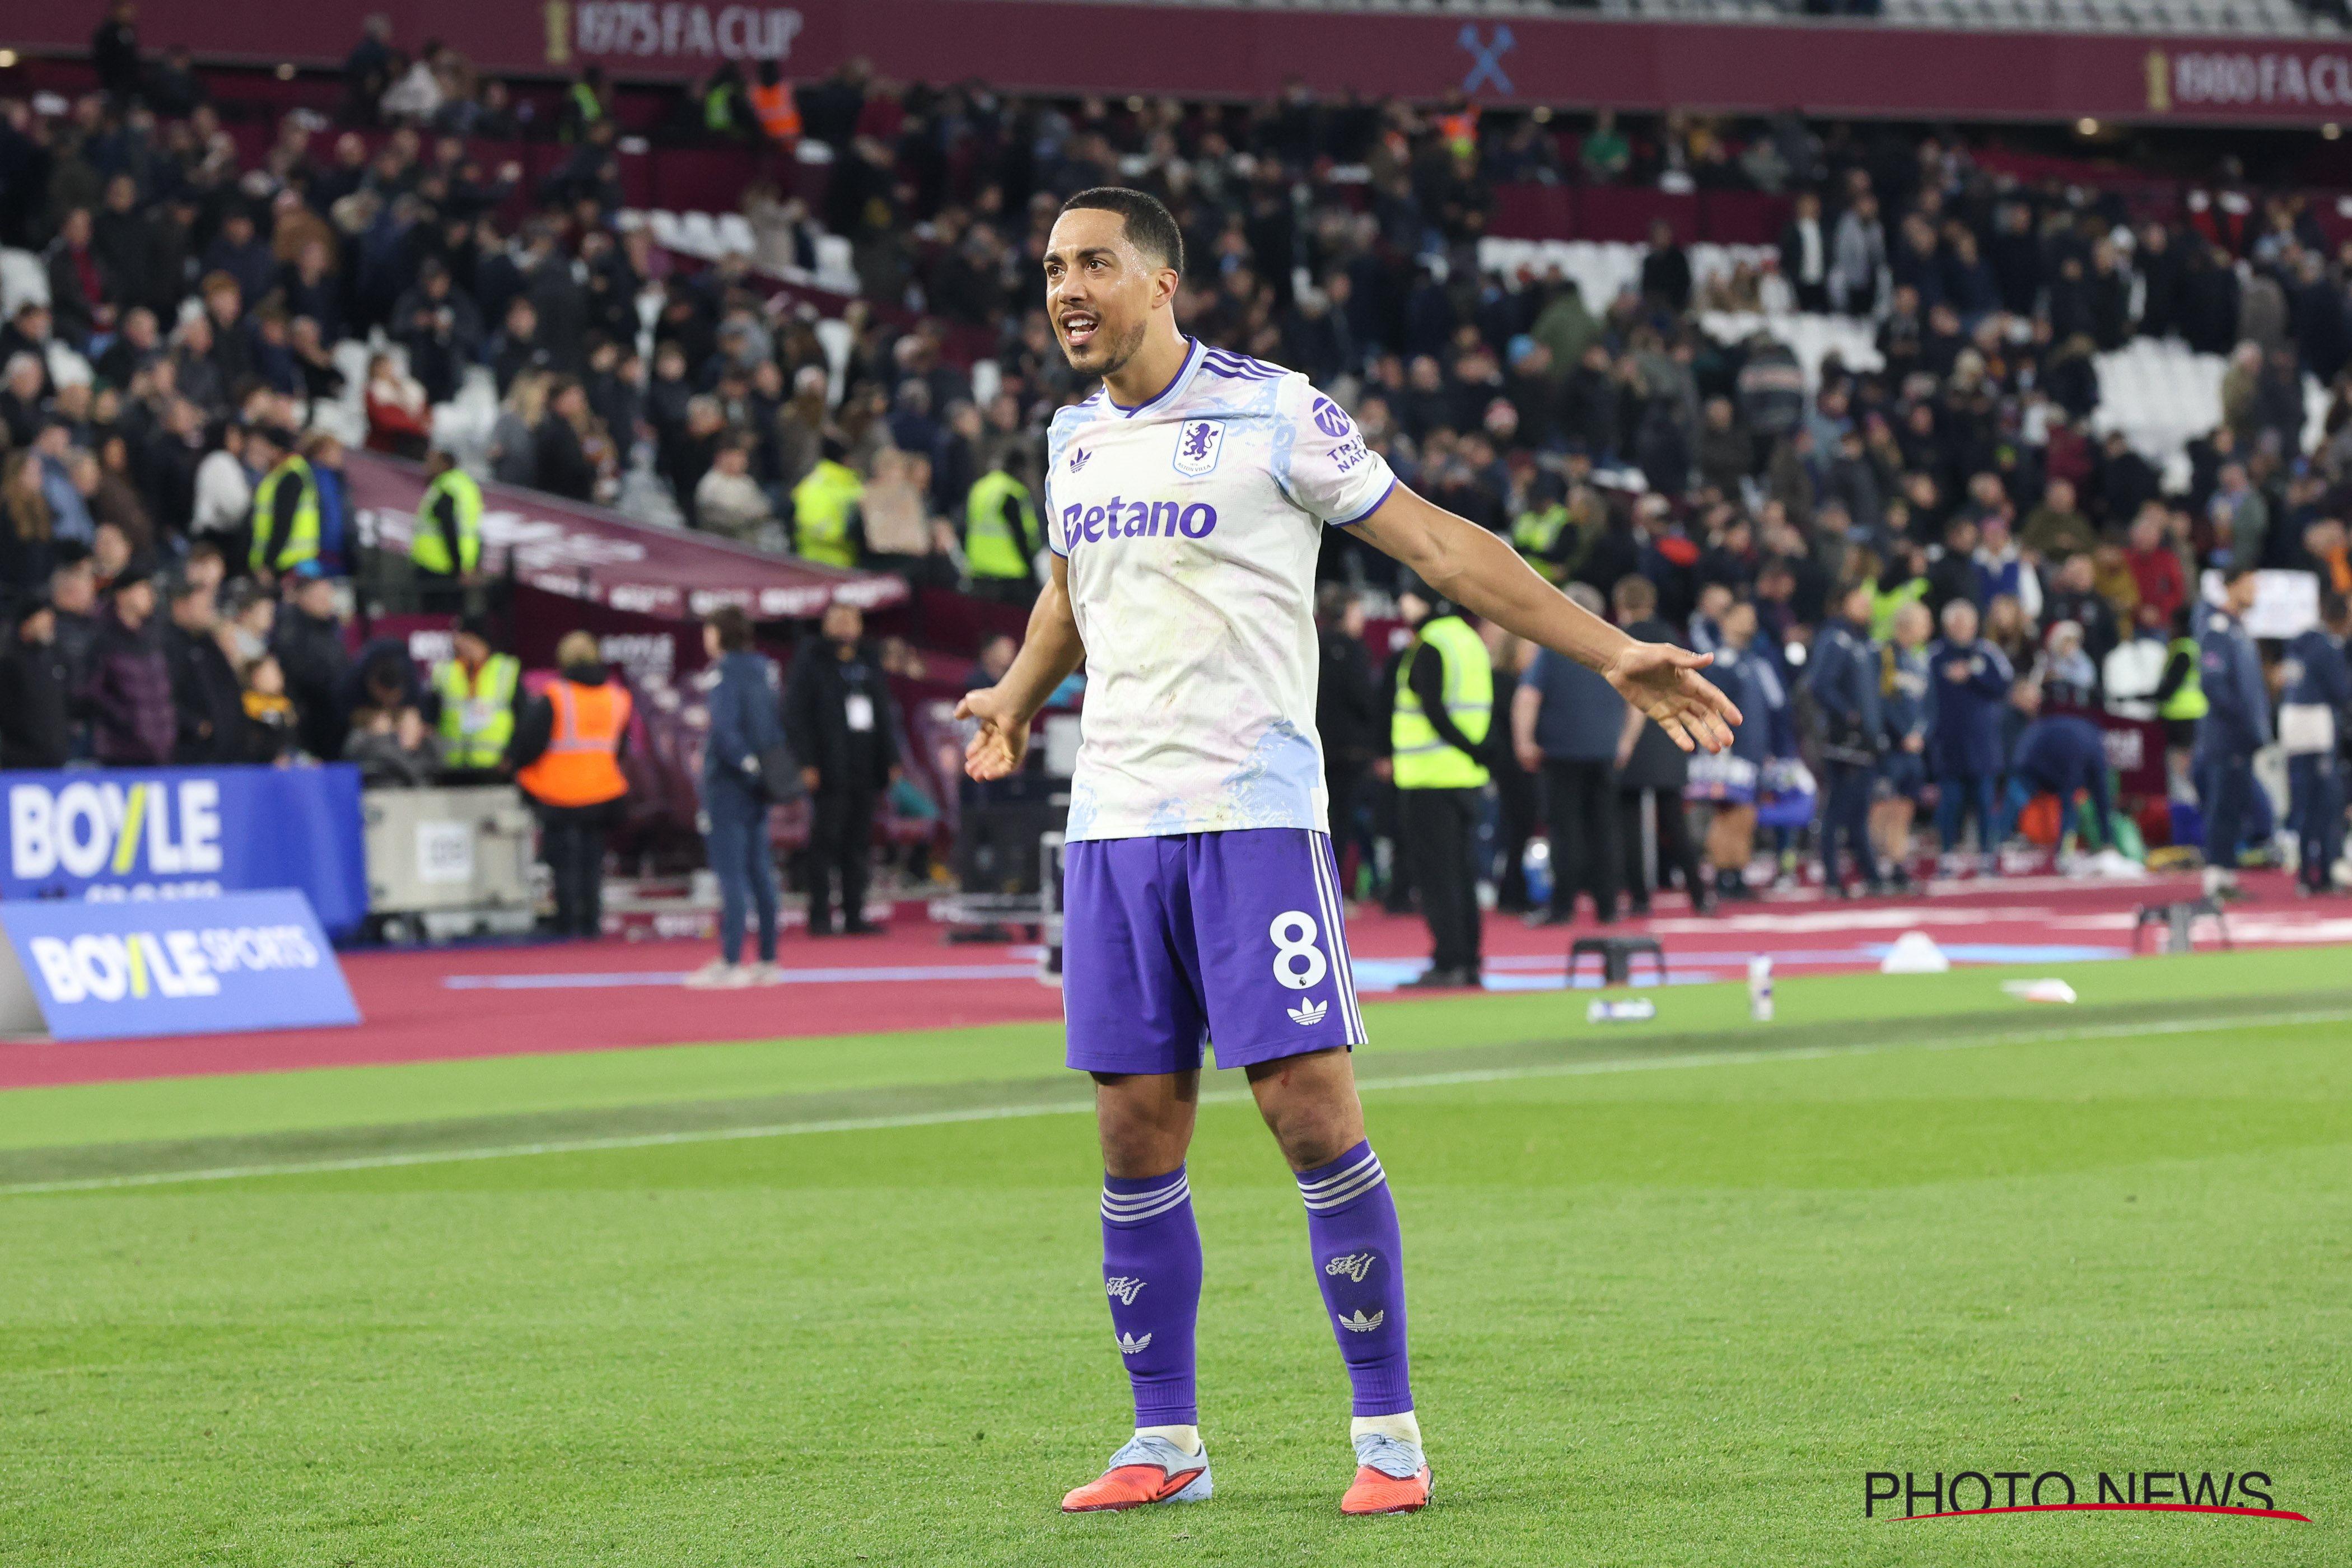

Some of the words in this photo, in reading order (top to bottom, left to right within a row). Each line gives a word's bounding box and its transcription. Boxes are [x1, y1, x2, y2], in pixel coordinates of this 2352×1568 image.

[717, 7, 804, 59] CUP
[2309, 55, 2352, 105] CU
[1178, 463, 1194, 472] ASTON
[1063, 496, 1217, 554] Betano
[8, 779, 223, 879] BOYLE
[1270, 910, 1327, 990] 8
